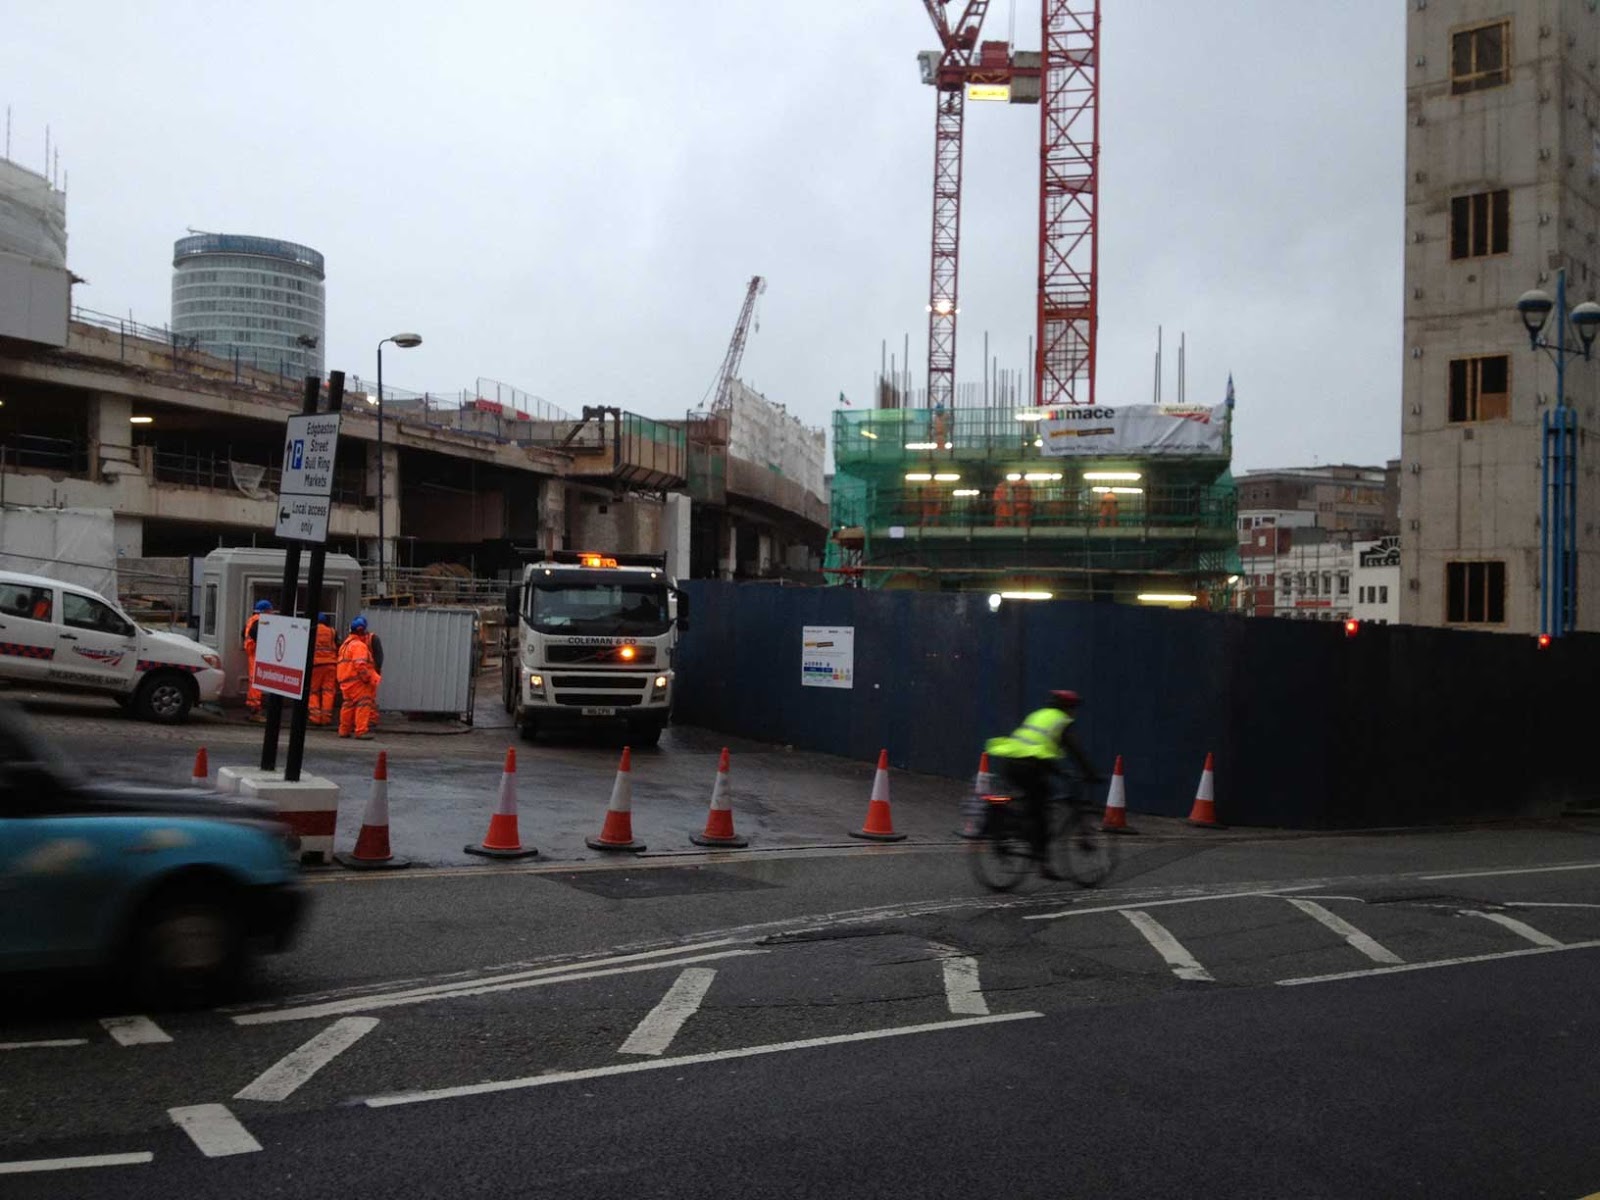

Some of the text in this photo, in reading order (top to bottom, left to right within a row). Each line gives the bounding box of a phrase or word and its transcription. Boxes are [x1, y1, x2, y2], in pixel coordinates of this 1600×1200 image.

[1066, 408, 1115, 419] mace
[306, 422, 336, 437] Edgbaston
[310, 439, 329, 452] Street
[304, 456, 331, 472] Bull Ring
[304, 473, 328, 487] Markets
[292, 501, 327, 517] Local access
[300, 520, 313, 536] only
[568, 636, 613, 645] COLEMAN
[623, 637, 637, 645] CO
[72, 644, 108, 656] Network
[48, 669, 104, 685] RESPONSE
